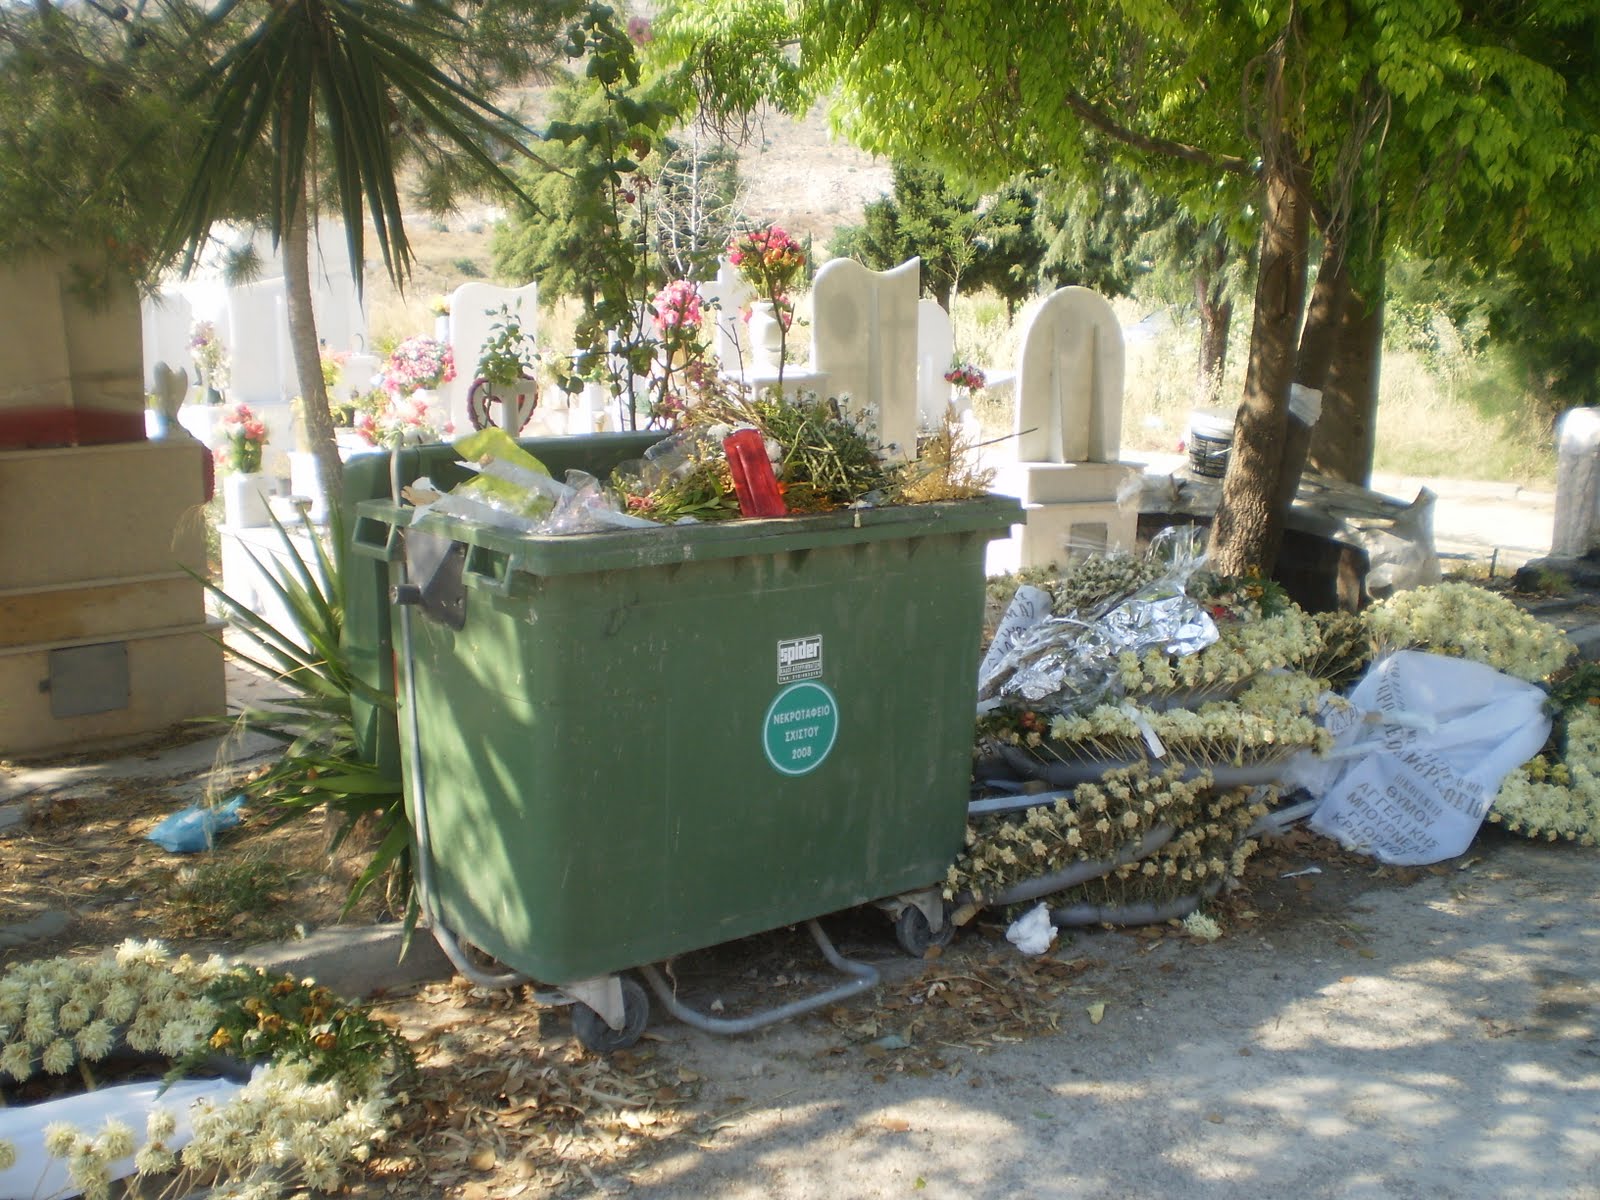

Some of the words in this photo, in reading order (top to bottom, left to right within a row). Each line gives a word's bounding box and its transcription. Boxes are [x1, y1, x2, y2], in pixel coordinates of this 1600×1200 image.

[780, 640, 820, 665] spider
[773, 704, 830, 725] ΝΕΚΡΟΤΑΦΕΙΟ
[785, 726, 819, 742] ΣΧΙΣΤΟΥ
[792, 746, 812, 759] 2008
[1359, 782, 1440, 849] ΑΓΓΕΛΙΚΗΣ
[1386, 785, 1435, 828] ΘΥΜΟΥ
